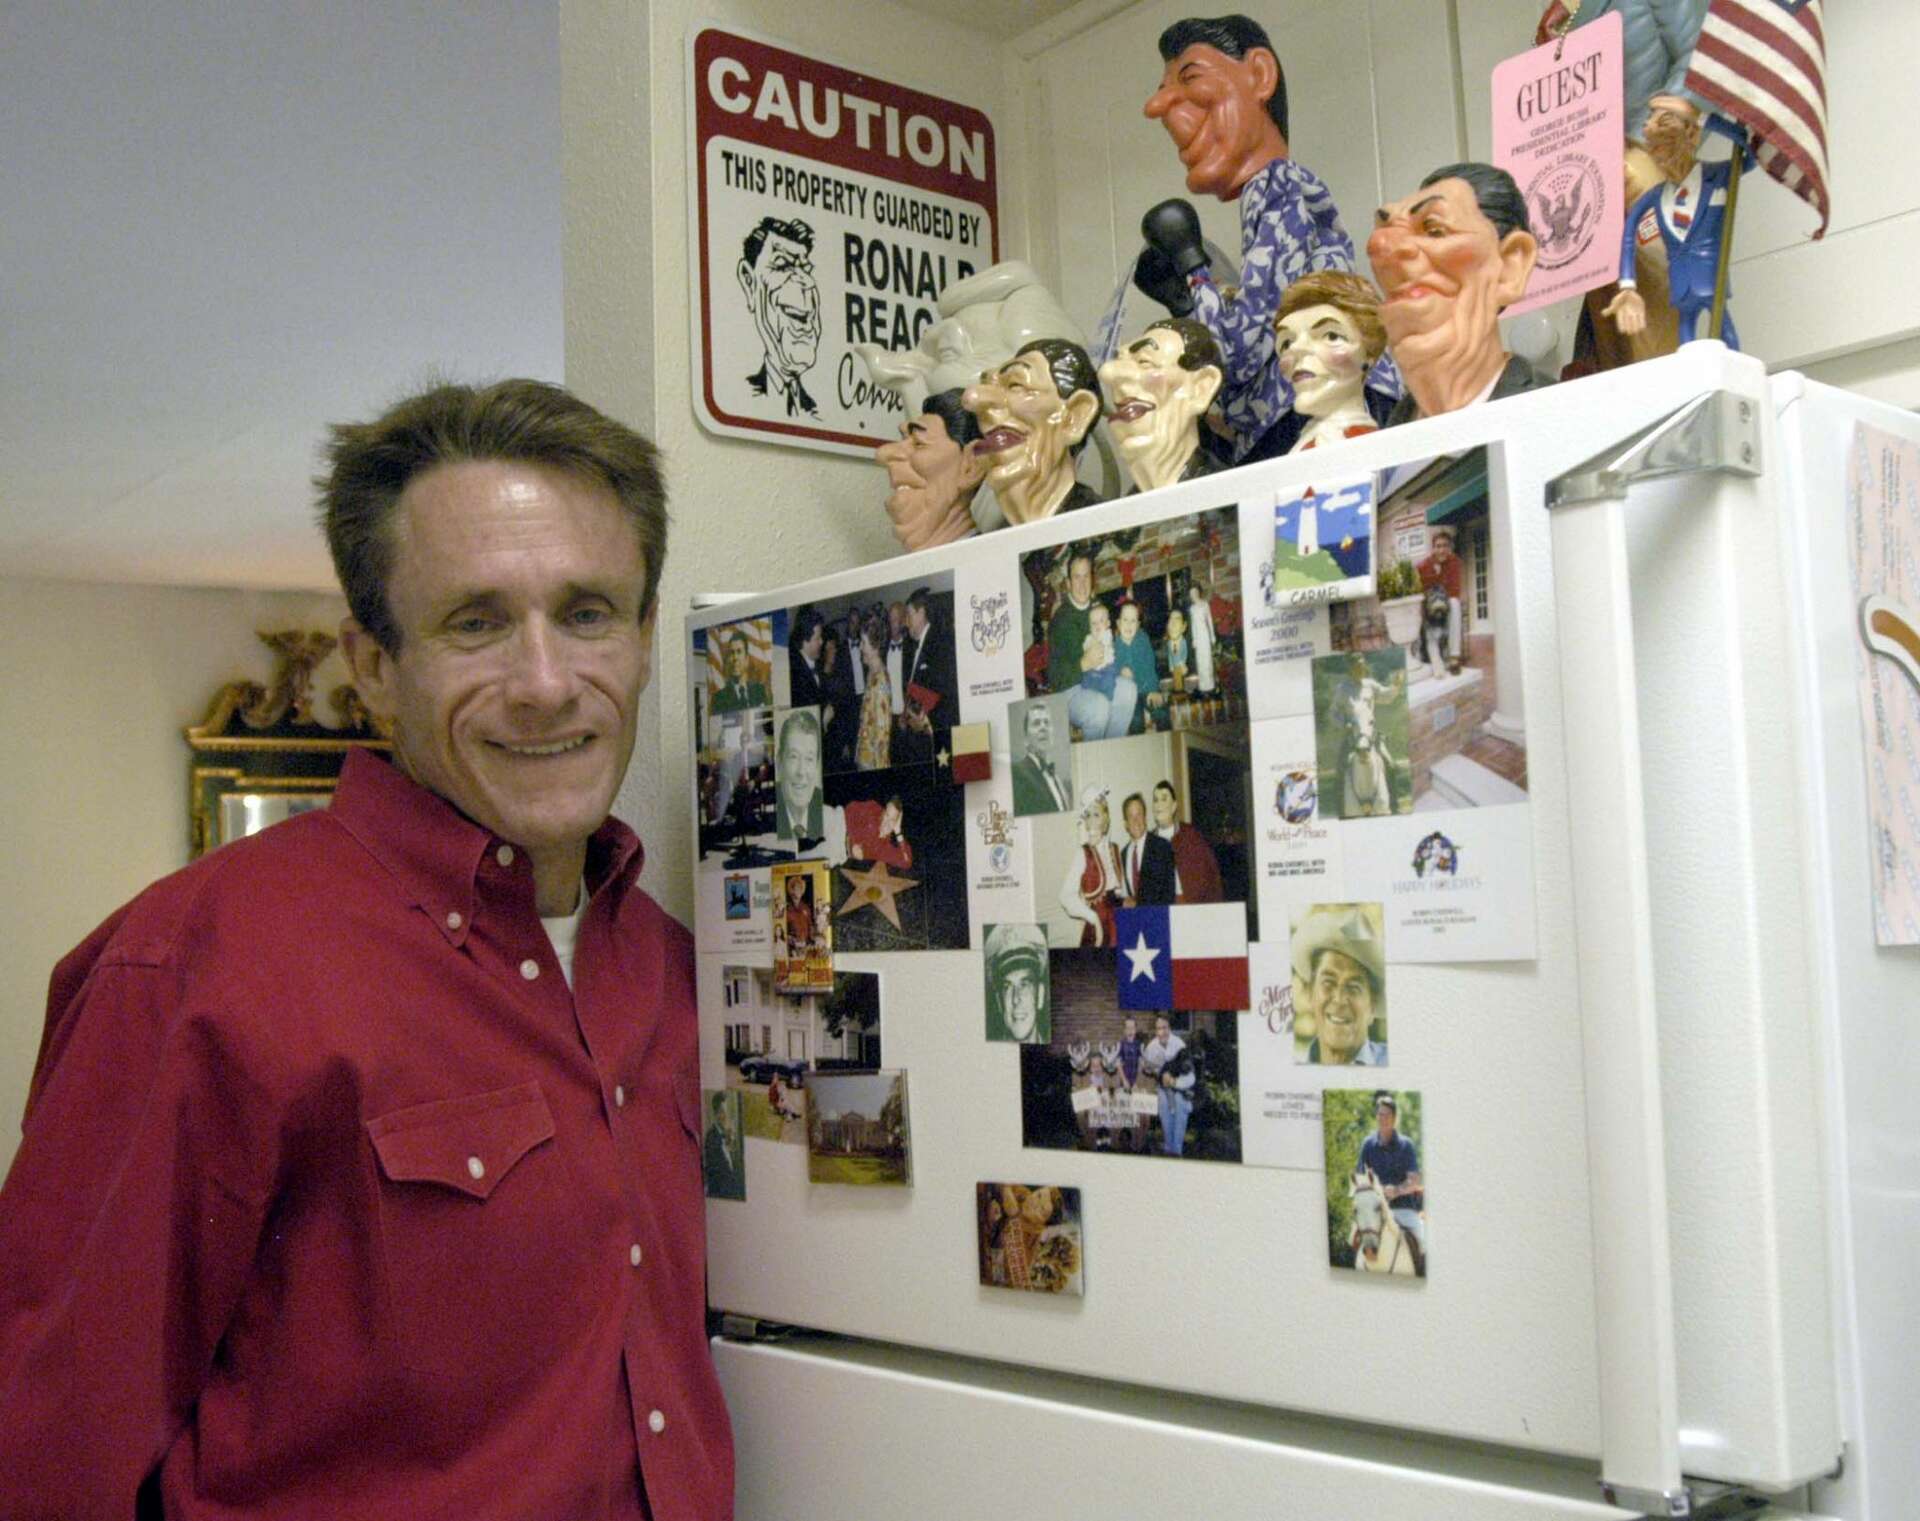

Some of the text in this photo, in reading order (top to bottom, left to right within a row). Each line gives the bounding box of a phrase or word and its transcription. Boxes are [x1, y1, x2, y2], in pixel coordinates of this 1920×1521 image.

[708, 57, 986, 182] CAUTION
[1517, 52, 1602, 122] GUEST
[1511, 110, 1607, 157] PRESIDENTIAL LIBRARY
[721, 150, 980, 248] THIS PROPERTY GUARDED BY
[1290, 586, 1344, 605] CARMEL
